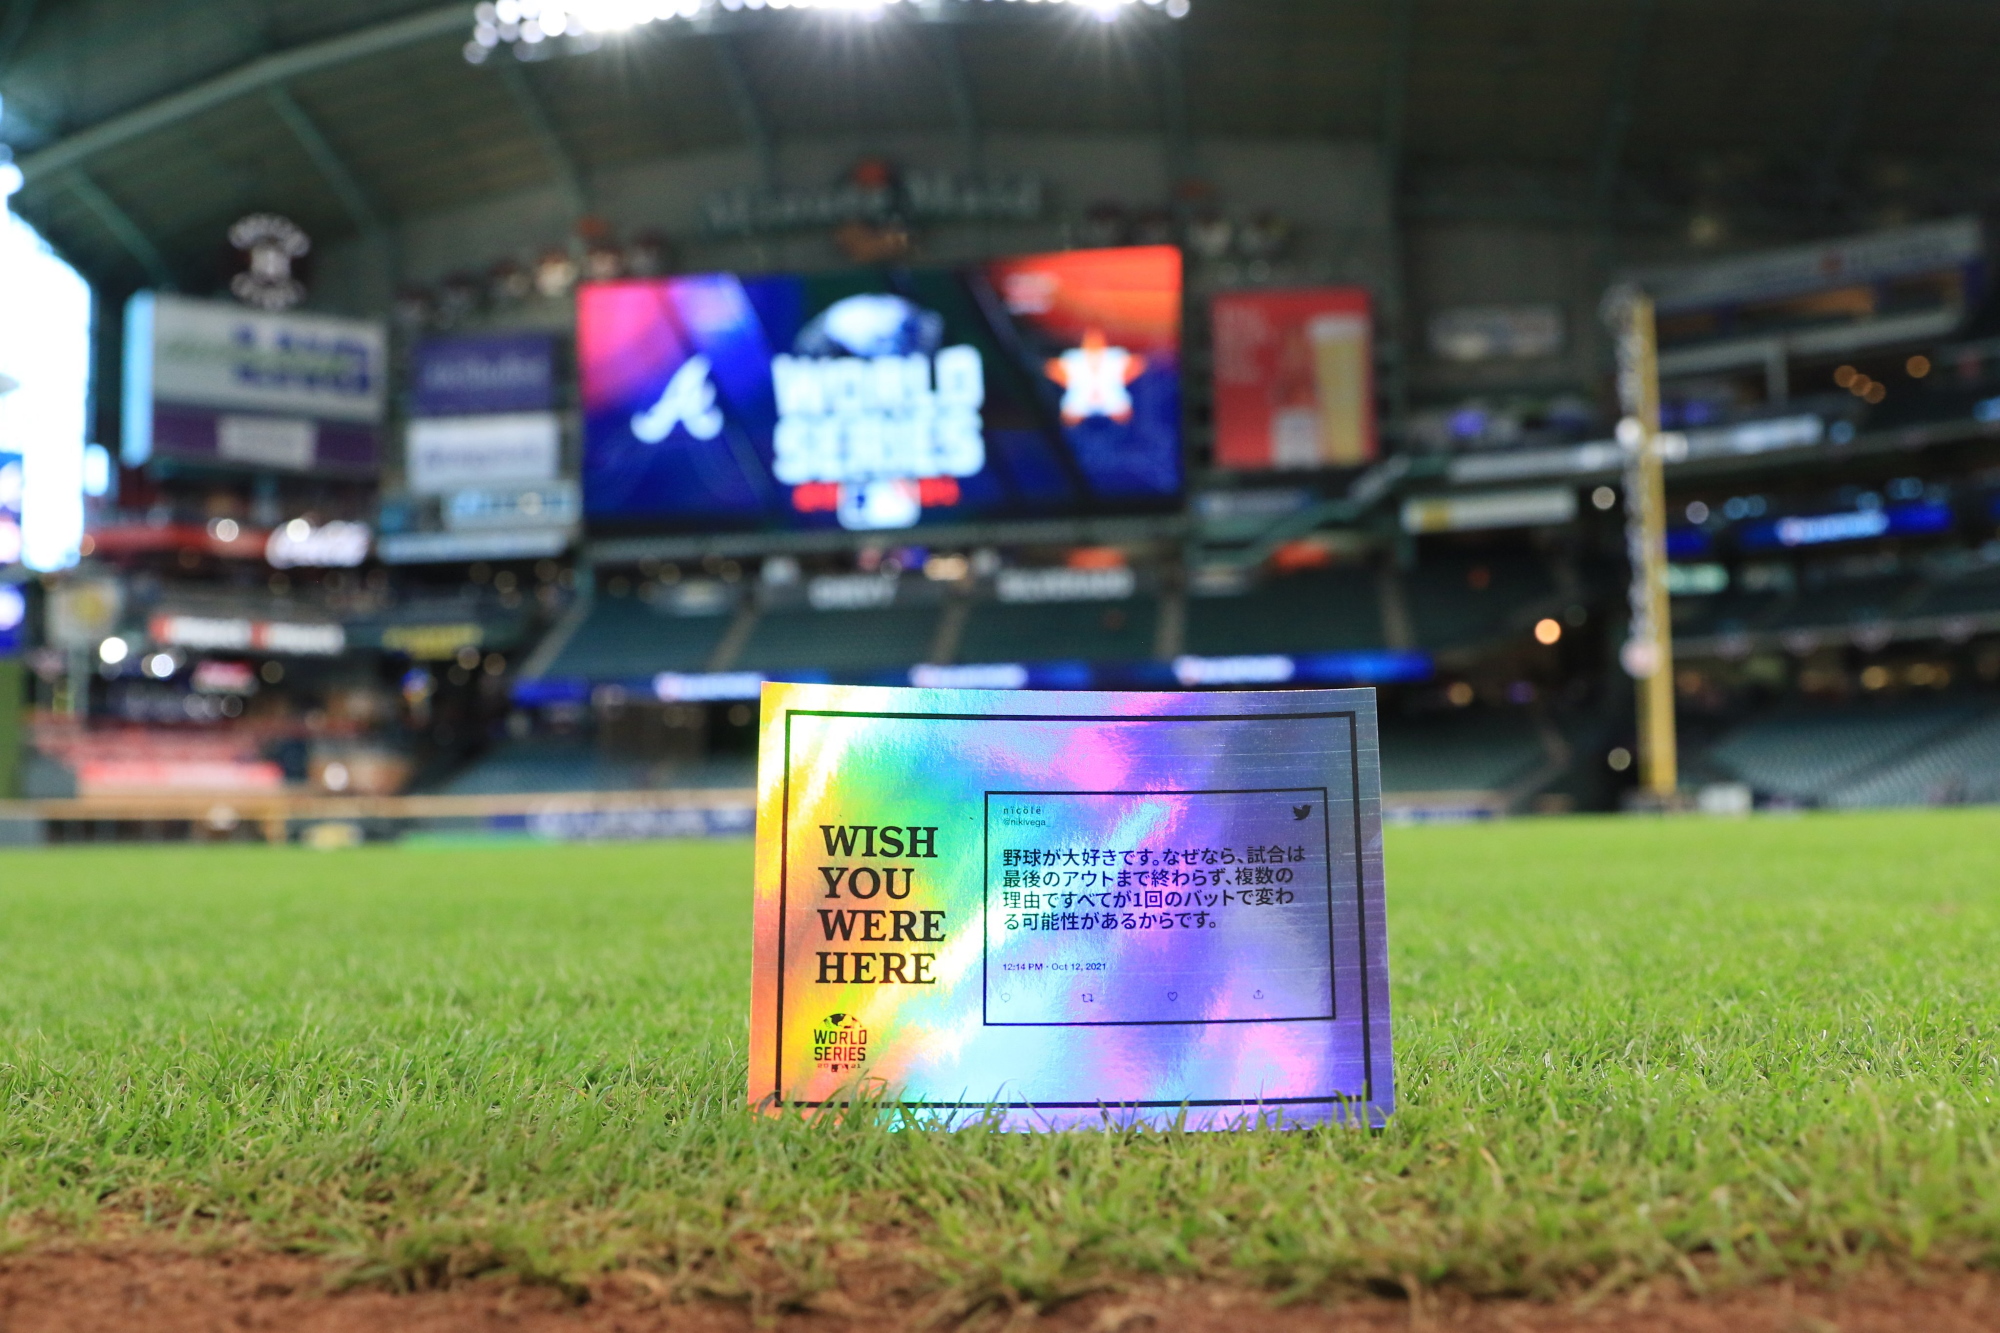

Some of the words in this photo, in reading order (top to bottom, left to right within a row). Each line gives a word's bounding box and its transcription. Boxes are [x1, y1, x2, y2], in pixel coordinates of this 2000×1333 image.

[819, 825, 939, 858] WISH
[818, 867, 915, 900] YOU
[1002, 866, 1294, 889] 最後のアウトまで終わらず、複数の
[1002, 887, 1294, 910] 理由ですべてが1回のバットで変わ
[817, 909, 947, 942] WERE
[1003, 911, 1217, 931] る可能性があるからです。
[815, 951, 937, 984] HERE
[1002, 963, 1026, 971] 12:14
[1028, 963, 1044, 971] PM
[1051, 963, 1068, 971] Oct
[1071, 963, 1084, 972] 12,
[1085, 962, 1107, 971] 2021
[814, 1029, 867, 1045] WORLD
[814, 1046, 866, 1061] SERIES
